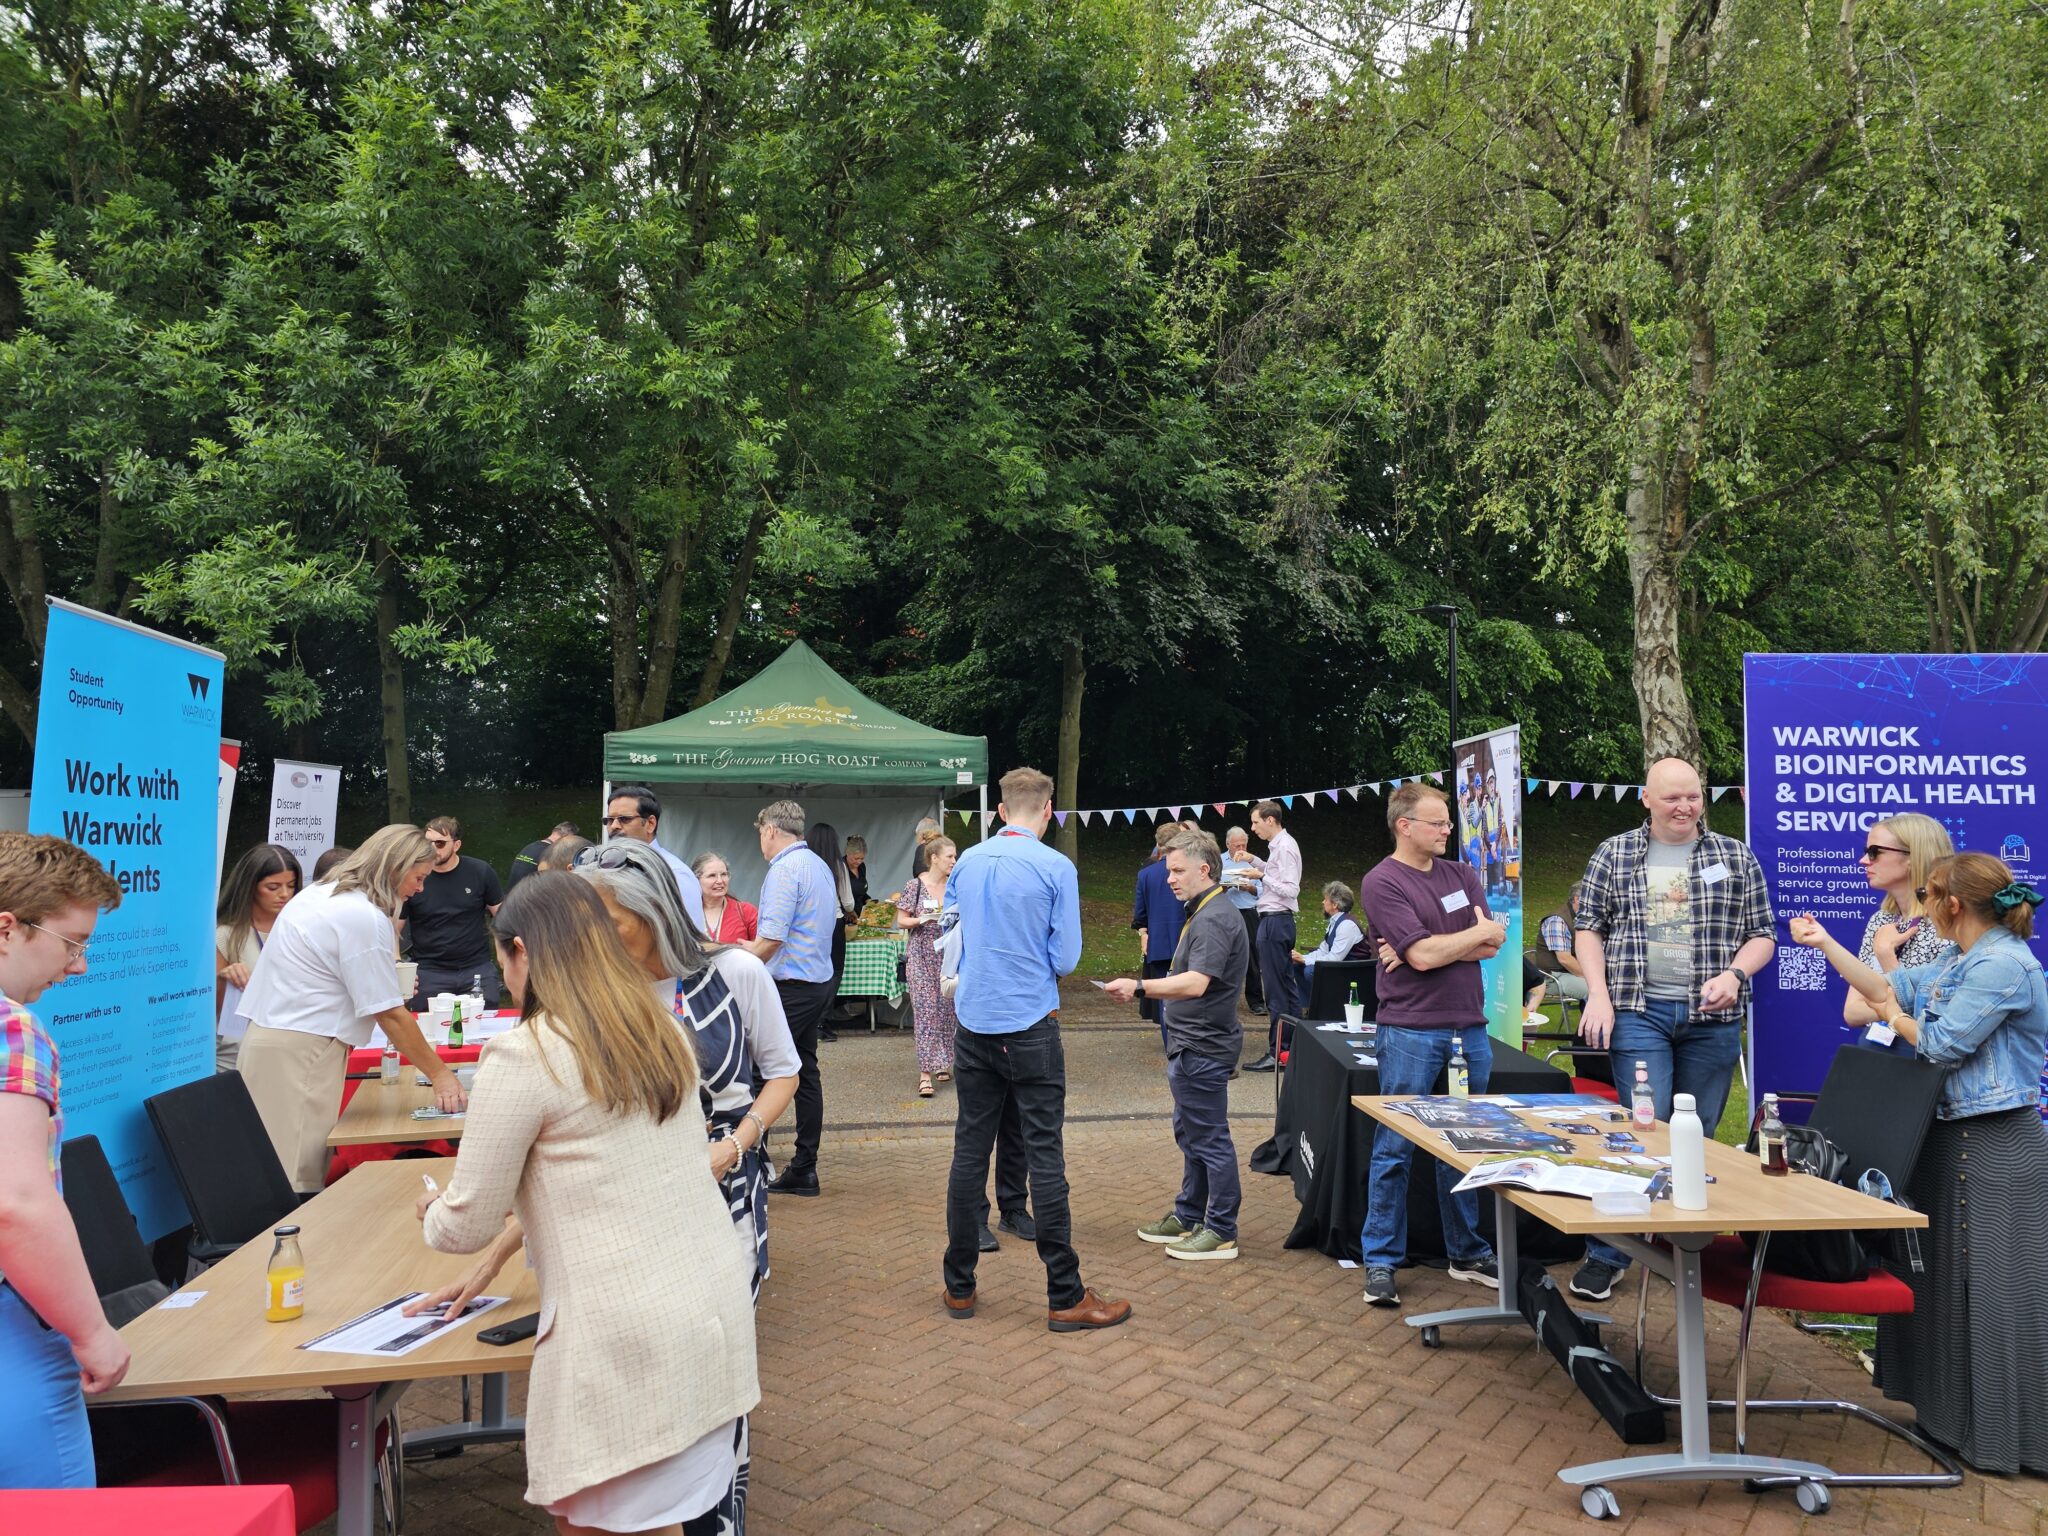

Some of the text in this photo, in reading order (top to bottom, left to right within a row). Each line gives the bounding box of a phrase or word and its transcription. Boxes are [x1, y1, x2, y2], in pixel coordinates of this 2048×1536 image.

[69, 667, 104, 689] Student
[68, 690, 124, 715] Opportunity
[726, 702, 832, 718] THE Gourmet
[737, 715, 778, 724] HOG
[787, 712, 844, 724] ROAST
[1773, 726, 1920, 747] WARWICK
[673, 747, 928, 770] THE Gourmet HOG ROAST COMPANY
[1774, 754, 2026, 776] BIOINFORMATICS
[65, 758, 179, 800] Work with
[1775, 782, 2036, 805] & DIGITAL HEALTH
[277, 798, 301, 810] Discover
[63, 810, 163, 845] Warwick
[275, 816, 322, 828] permanent jobs
[1776, 810, 1908, 832] SERVIC
[274, 831, 325, 843] at The University
[1777, 847, 1855, 859] Professional
[1778, 878, 1868, 891] service grown
[1778, 892, 1877, 905] in an academic
[117, 928, 140, 942] could
[108, 948, 120, 961] for
[122, 948, 139, 963] your
[109, 965, 126, 981] and
[128, 963, 147, 977] Work
[148, 958, 188, 976] Experience
[158, 991, 169, 1002] will
[169, 989, 185, 1001] work
[185, 987, 198, 998] with
[53, 1004, 121, 1026] Partner with us to
[60, 1038, 83, 1050] Access
